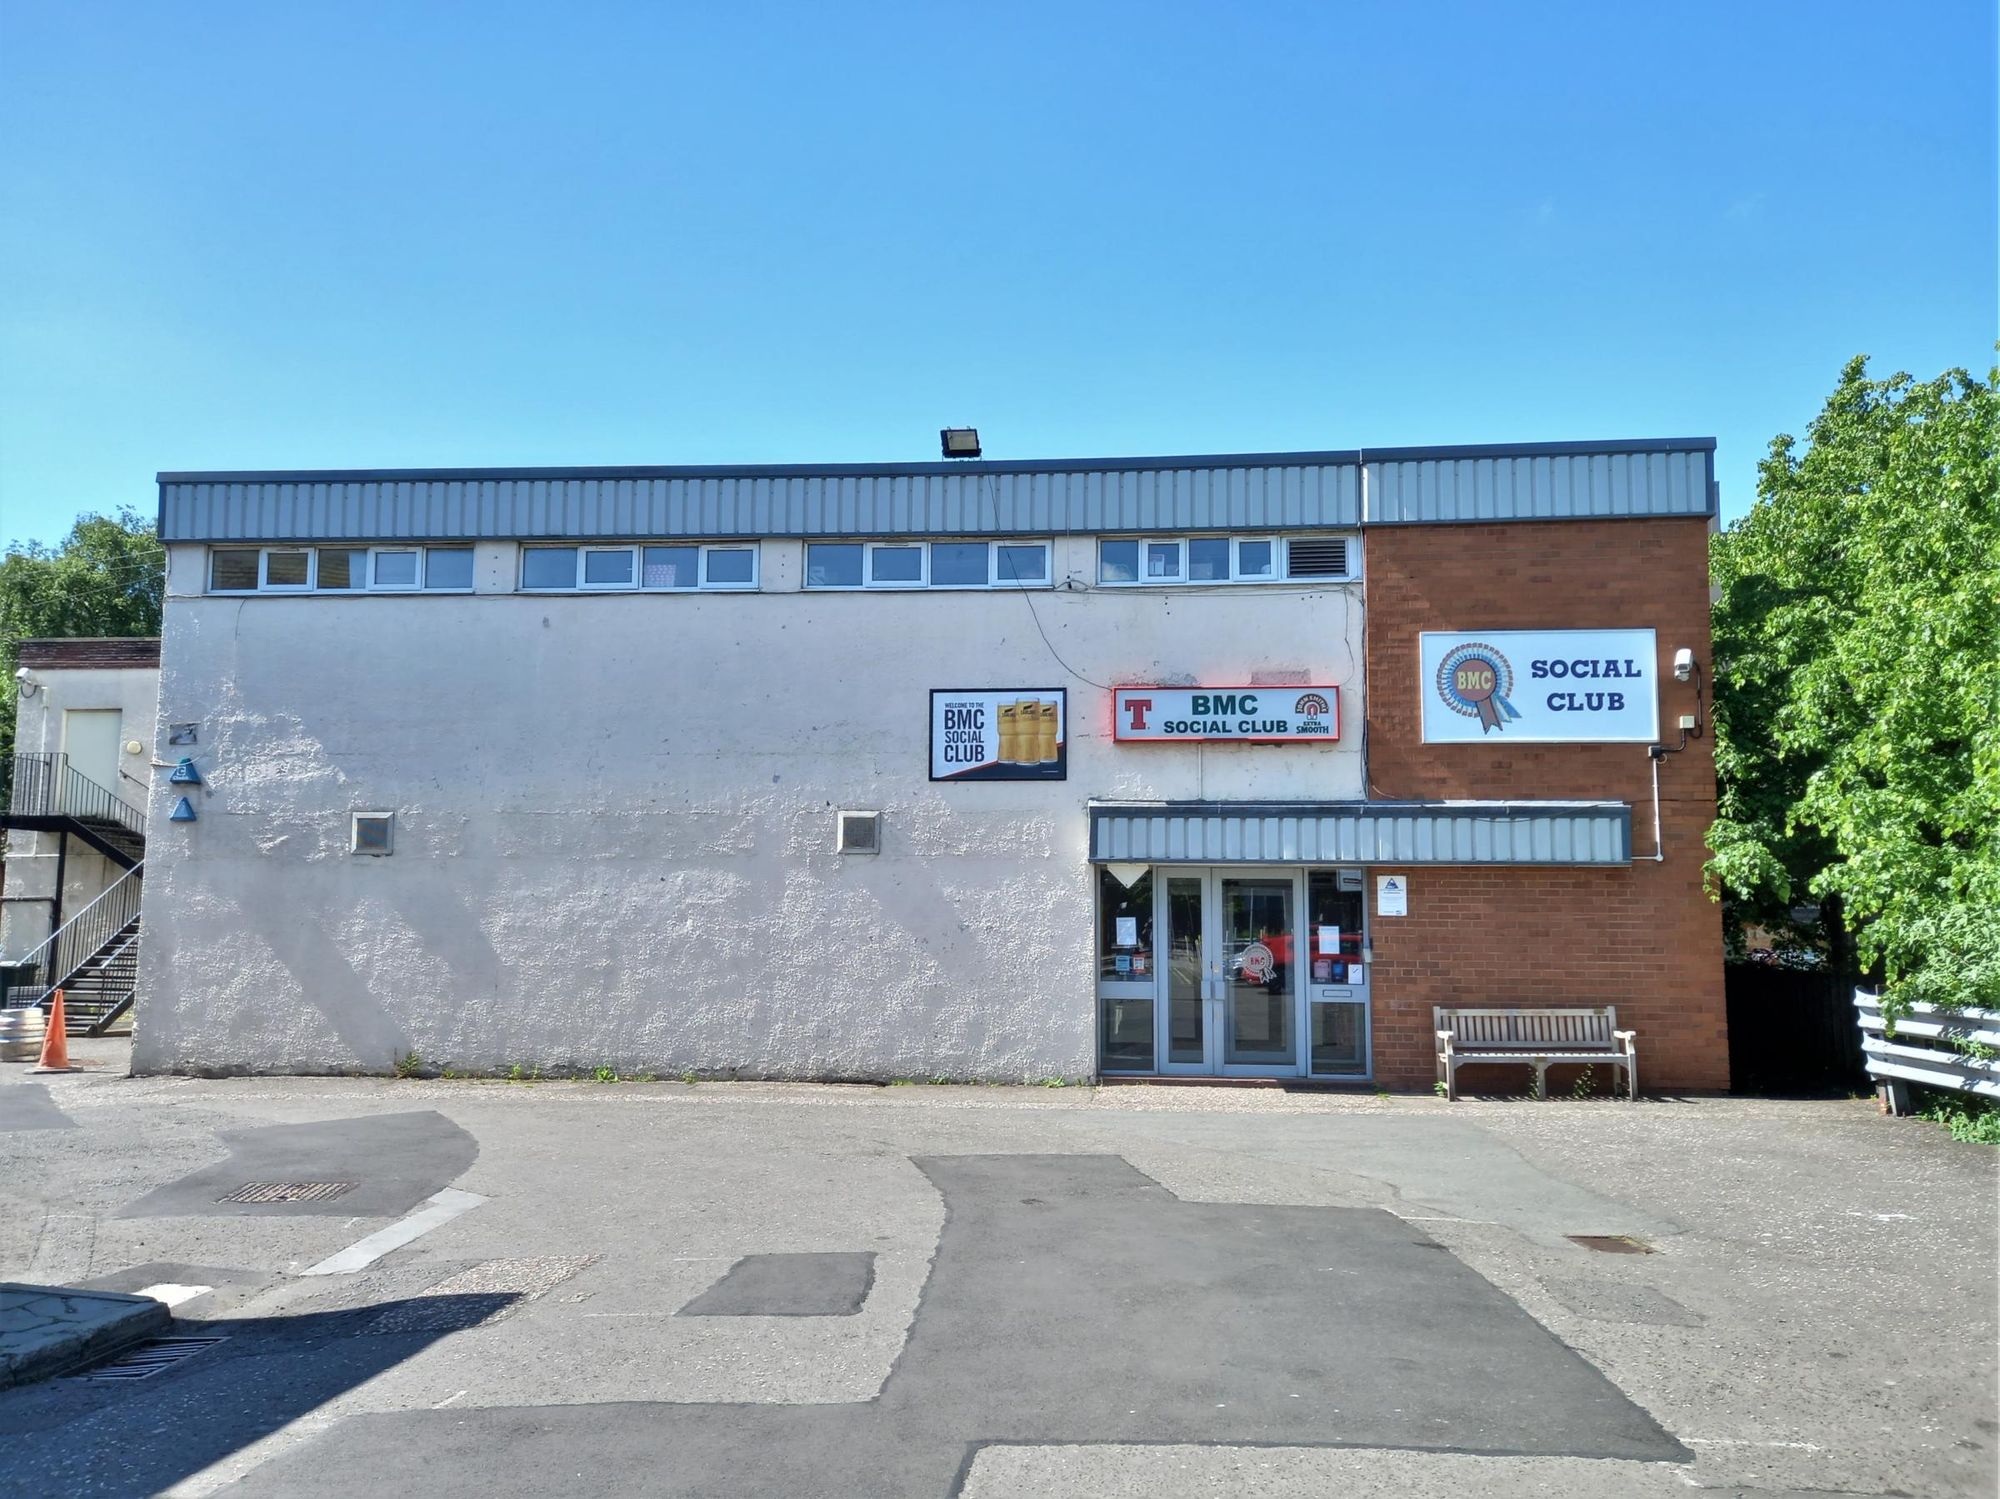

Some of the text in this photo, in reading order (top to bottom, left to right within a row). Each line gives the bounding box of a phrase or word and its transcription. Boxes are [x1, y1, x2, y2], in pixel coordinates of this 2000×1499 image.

[1531, 659, 1641, 678] SOCIAL
[1456, 670, 1492, 690] BMC
[1191, 695, 1258, 716] BMC
[1546, 692, 1625, 712] CLUB
[944, 709, 985, 730] BMC
[1124, 699, 1152, 730] T
[945, 730, 984, 743] SOCIAL
[1163, 720, 1288, 734] SOCIAL CLUB
[1296, 726, 1329, 734] SMOOTH
[944, 744, 985, 763] CLUB
